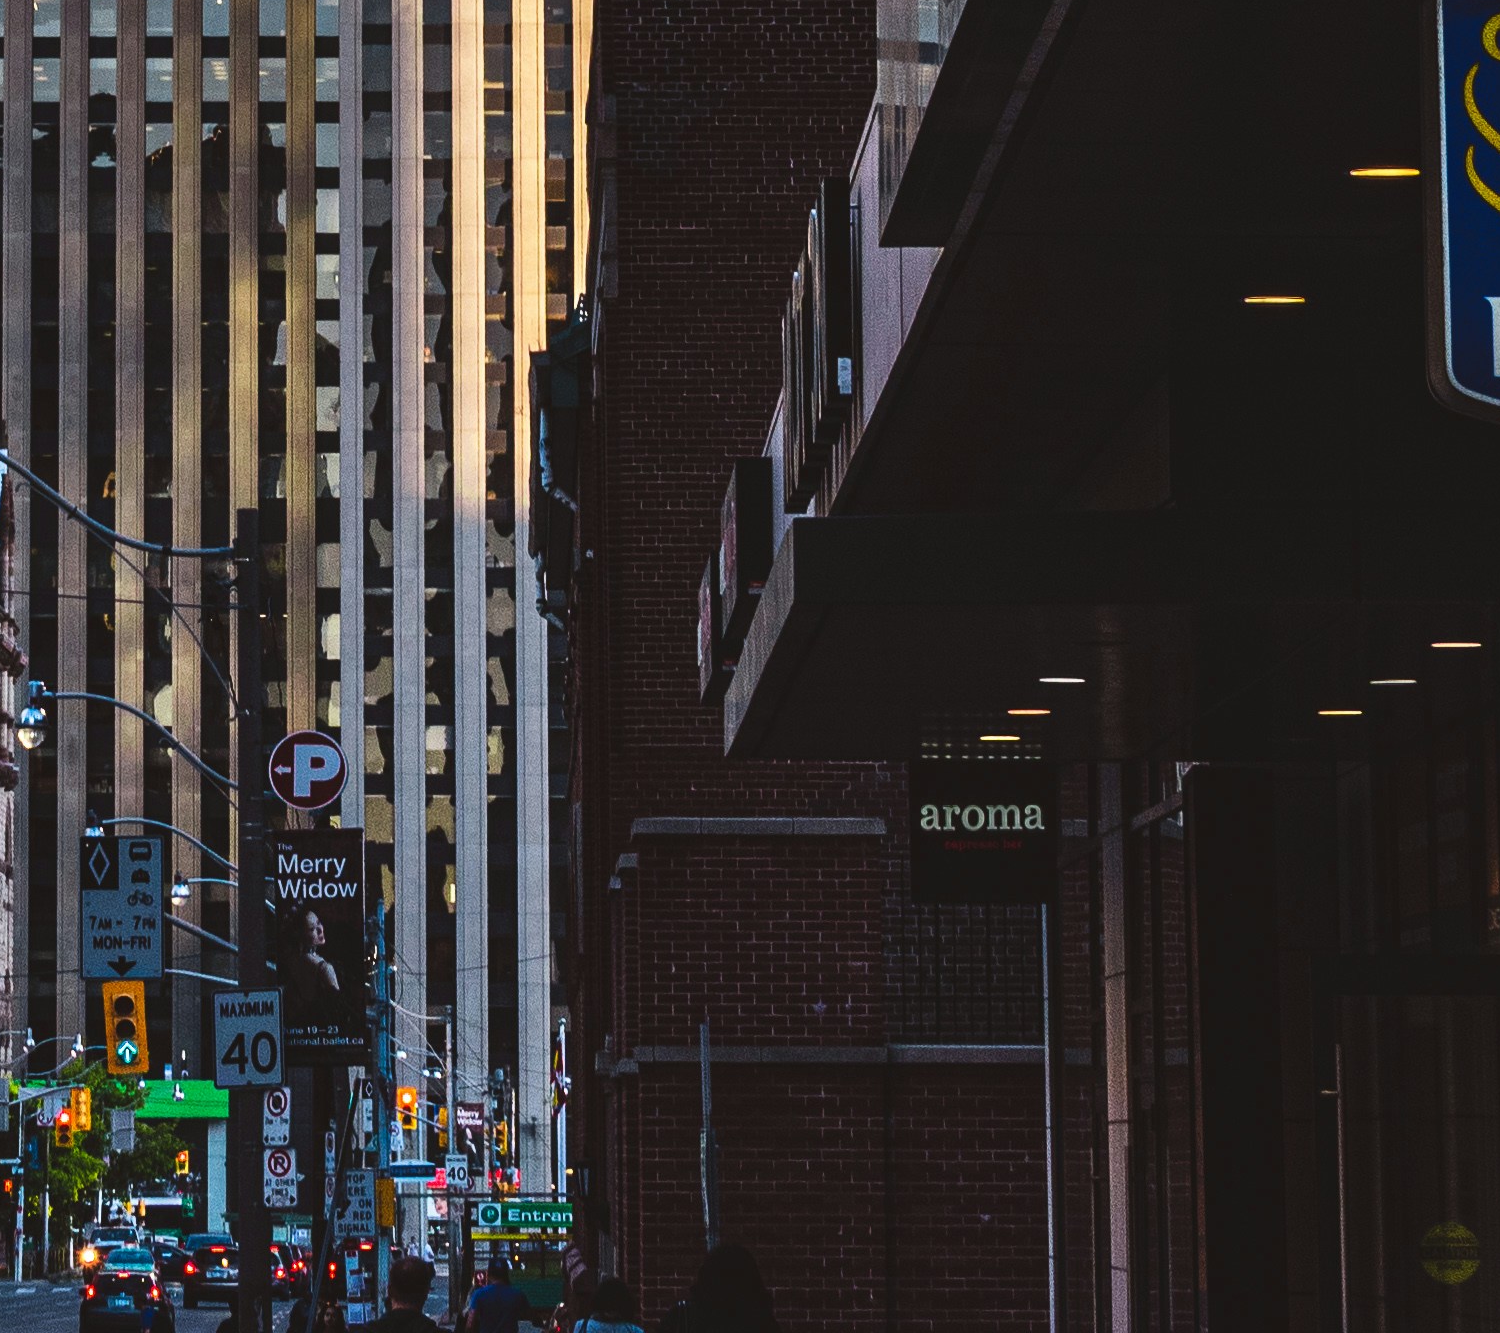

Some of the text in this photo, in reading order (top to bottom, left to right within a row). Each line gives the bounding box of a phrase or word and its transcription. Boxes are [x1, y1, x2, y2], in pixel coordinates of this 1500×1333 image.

[293, 744, 342, 798] P
[919, 803, 1046, 832] aroma
[277, 843, 293, 852] The
[278, 853, 347, 878] Merry
[277, 878, 358, 900] Widow
[92, 935, 152, 950] MON-FRI
[219, 1000, 275, 1019] MAXIMUM
[221, 1030, 278, 1075] 40
[347, 1173, 366, 1185] TOP
[447, 1166, 467, 1181] 40
[347, 1186, 367, 1197] ERE
[358, 1198, 372, 1209] ON
[353, 1210, 373, 1221] RED
[337, 1222, 371, 1233] SIGNAL
